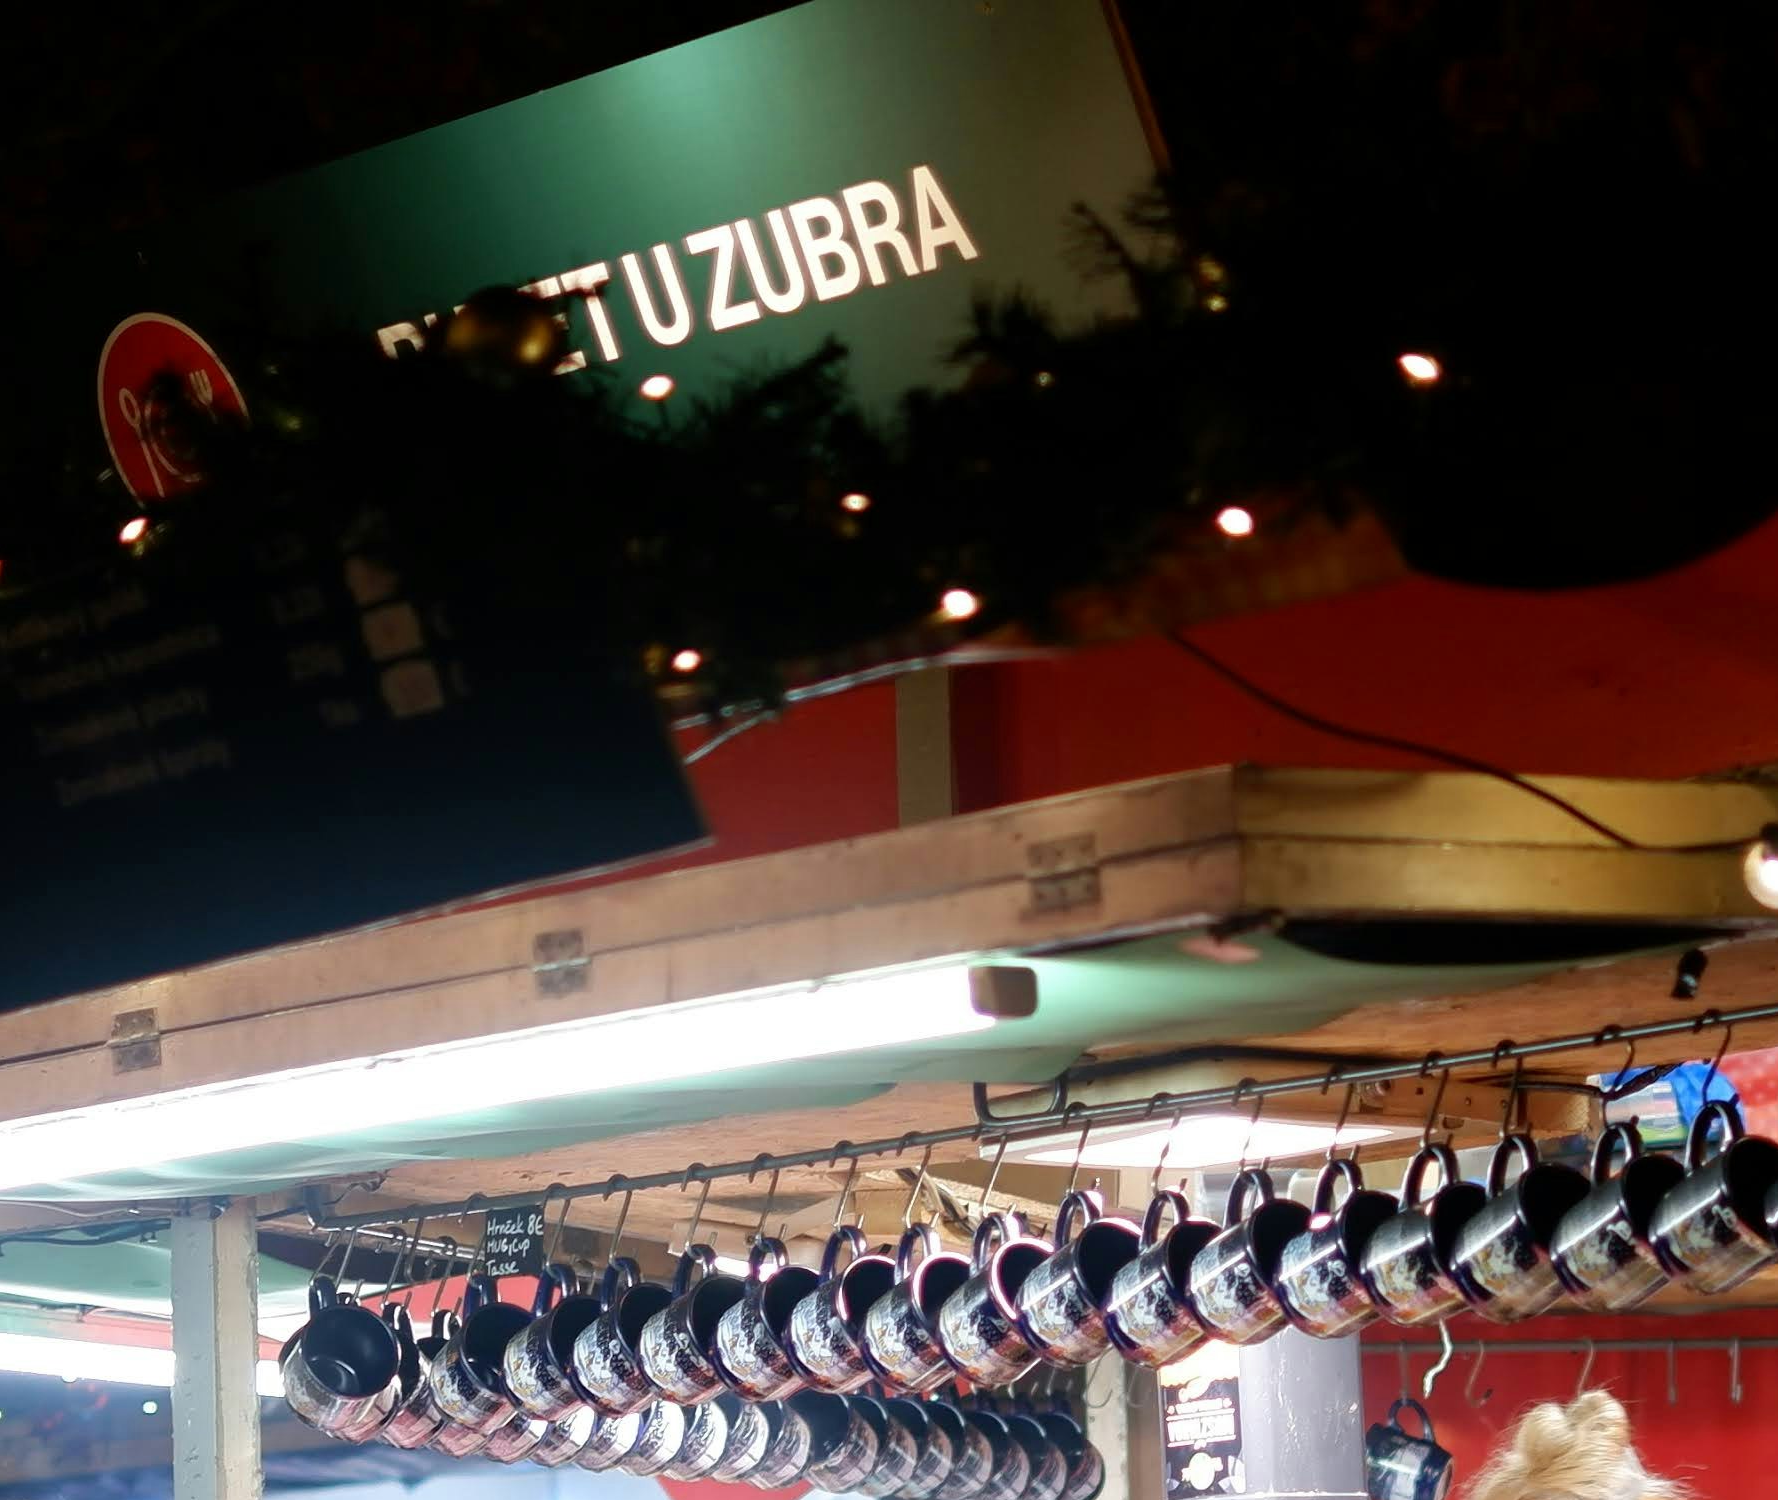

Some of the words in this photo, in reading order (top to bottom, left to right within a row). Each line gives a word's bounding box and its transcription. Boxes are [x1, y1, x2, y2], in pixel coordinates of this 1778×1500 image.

[621, 240, 693, 348] U
[683, 164, 981, 336] ZUBRA
[486, 1260, 520, 1277] Tasse
